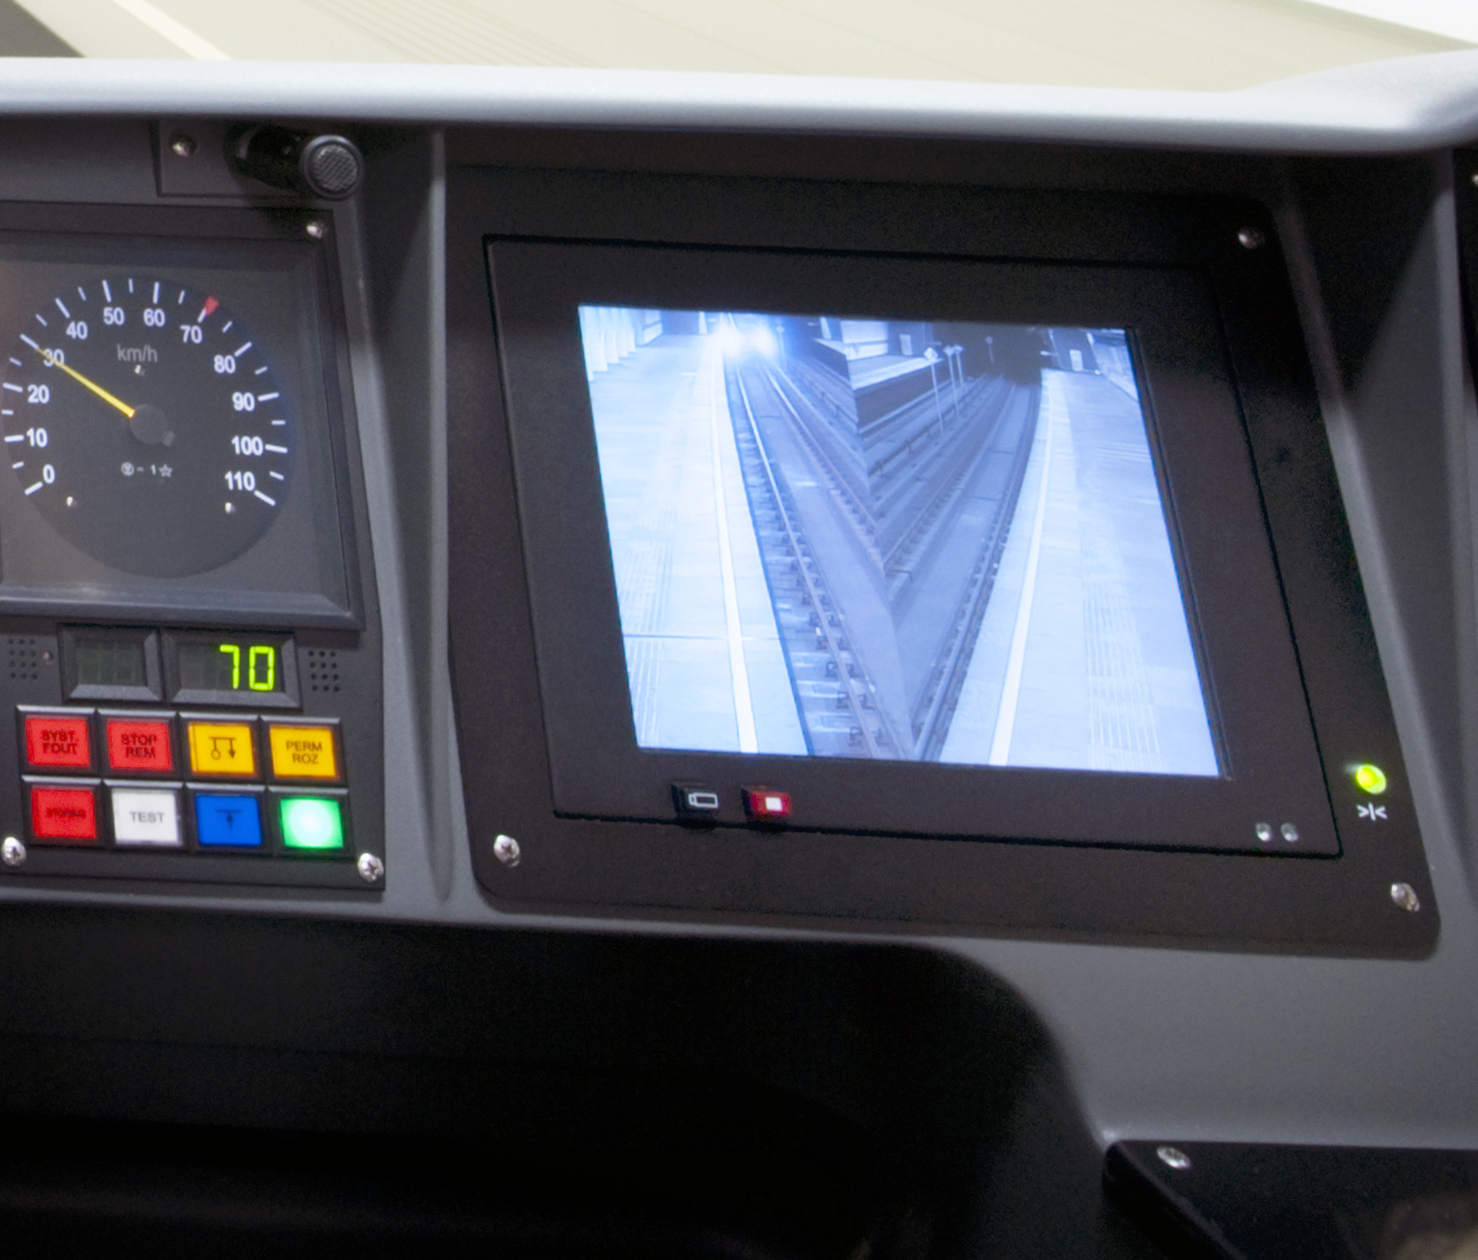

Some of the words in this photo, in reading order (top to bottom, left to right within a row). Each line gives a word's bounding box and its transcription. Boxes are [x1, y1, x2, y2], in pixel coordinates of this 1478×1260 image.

[103, 307, 125, 325] 50
[144, 309, 165, 328] 60
[66, 322, 89, 340] 40
[180, 325, 203, 344] 70
[117, 344, 159, 363] km/h
[214, 355, 237, 374] 80
[27, 384, 50, 404] 20
[232, 393, 255, 412] 90
[26, 428, 49, 447] 10
[231, 436, 264, 456] 100
[43, 465, 55, 483] 0
[224, 471, 255, 491] 110
[219, 644, 275, 690] 70
[125, 747, 157, 759] REM
[286, 741, 322, 752] PERM
[129, 811, 164, 823] TEST
